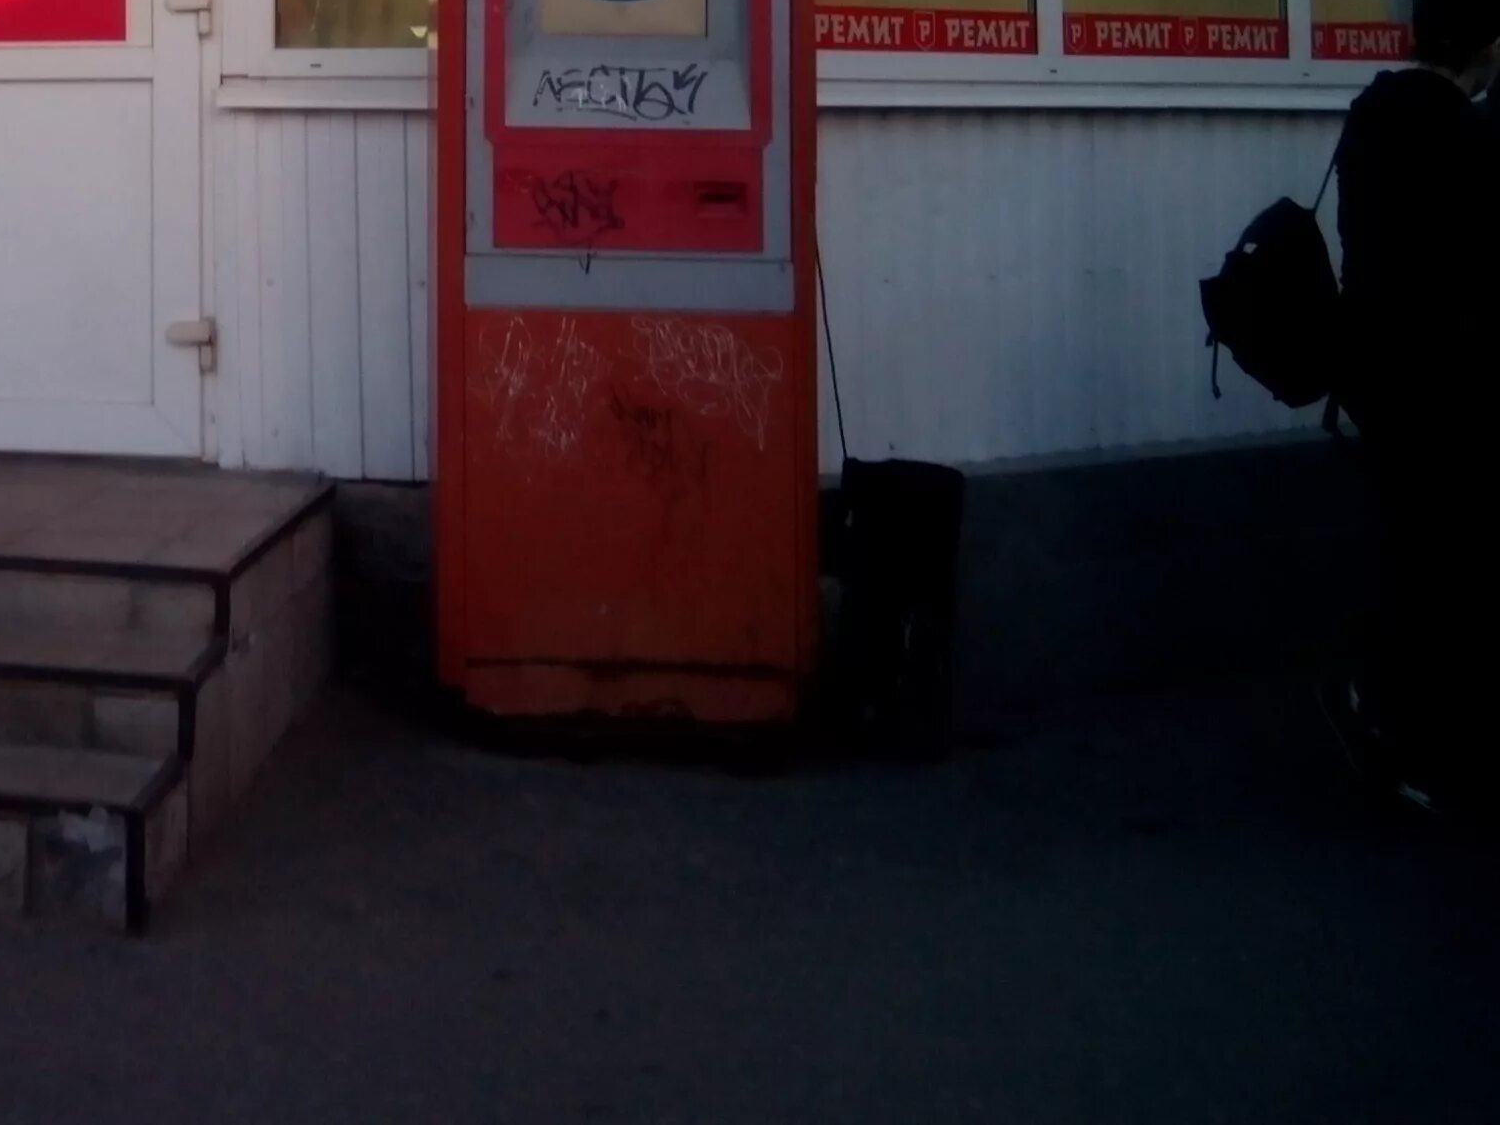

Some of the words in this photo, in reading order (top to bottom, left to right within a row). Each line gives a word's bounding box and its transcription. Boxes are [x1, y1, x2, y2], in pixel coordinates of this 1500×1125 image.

[814, 13, 904, 46] РЕМИТ
[944, 18, 1030, 49] РЕМИТ
[1093, 21, 1172, 50] РЕМИТ
[1206, 24, 1279, 52] РЕМИТ
[1334, 28, 1402, 55] РЕМИТ
